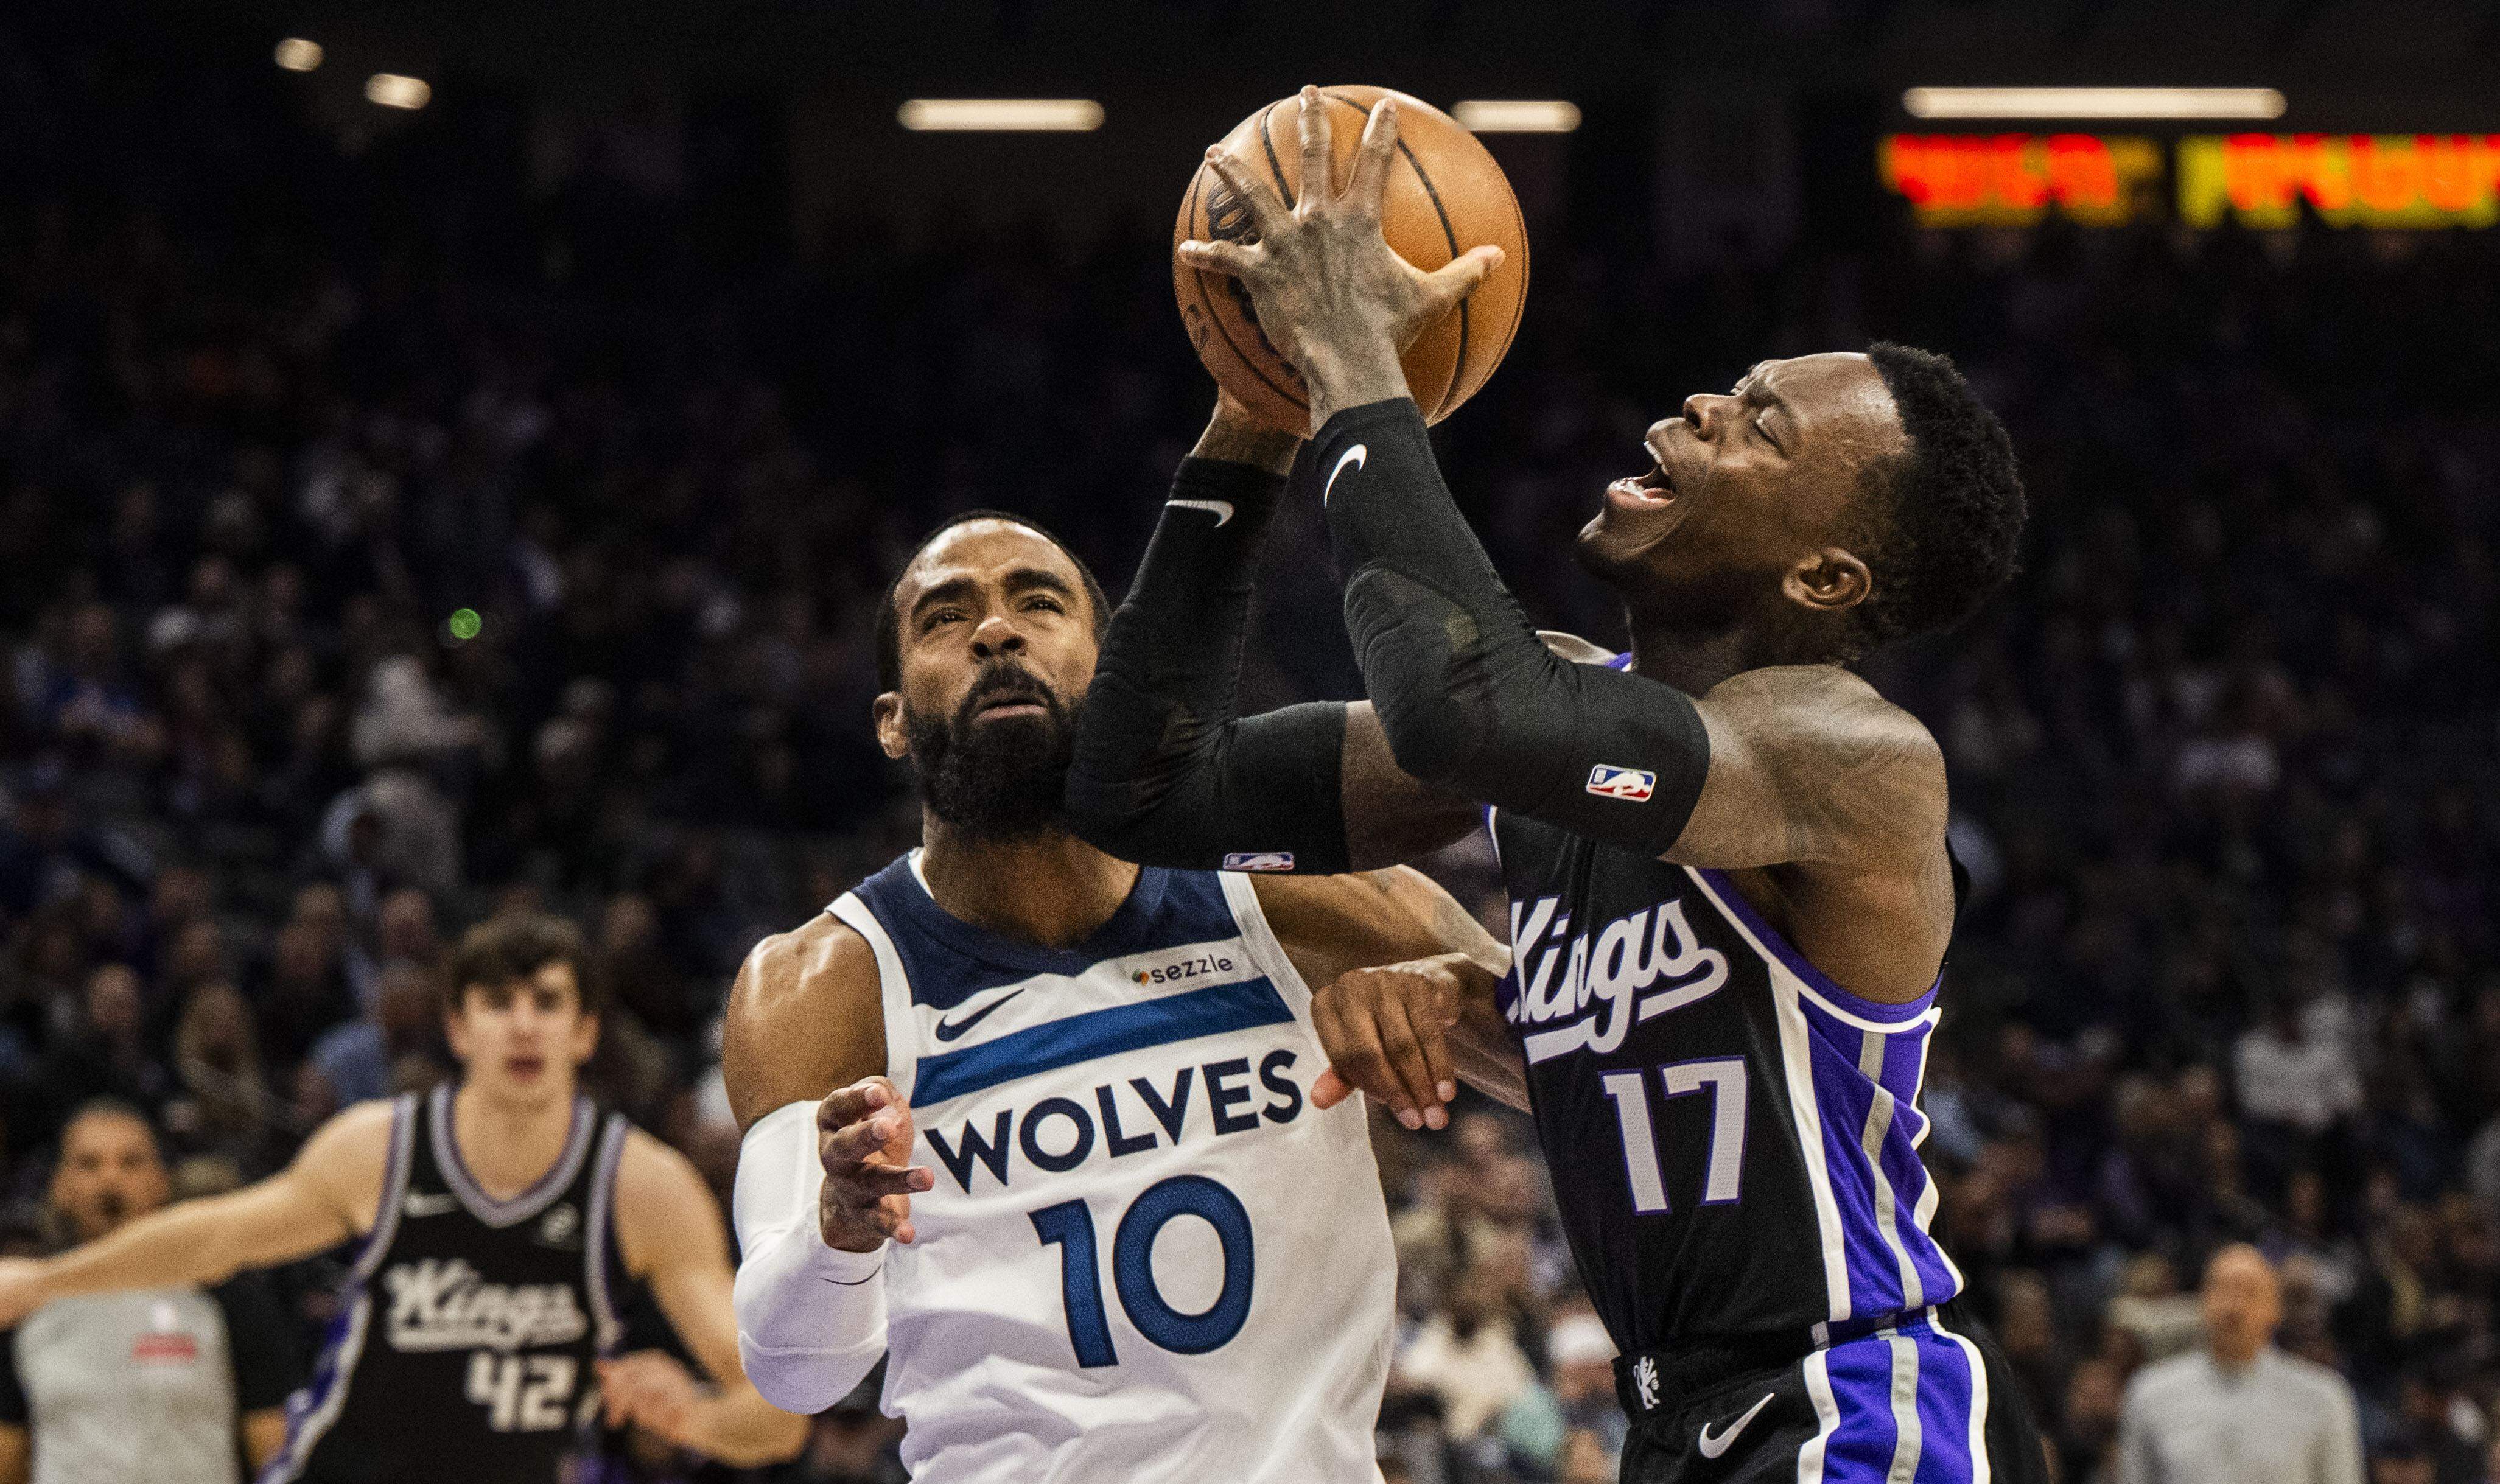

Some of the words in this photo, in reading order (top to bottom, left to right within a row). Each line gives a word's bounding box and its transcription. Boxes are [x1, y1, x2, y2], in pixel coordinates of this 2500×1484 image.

[1150, 954, 1233, 984] sezzle
[1506, 898, 1729, 1065] Kings
[923, 1049, 1303, 1194] WOLVES
[1598, 1055, 1749, 1216] 17
[387, 1258, 587, 1353] Kings
[1027, 1174, 1255, 1368] 10
[466, 1349, 578, 1431] 42
